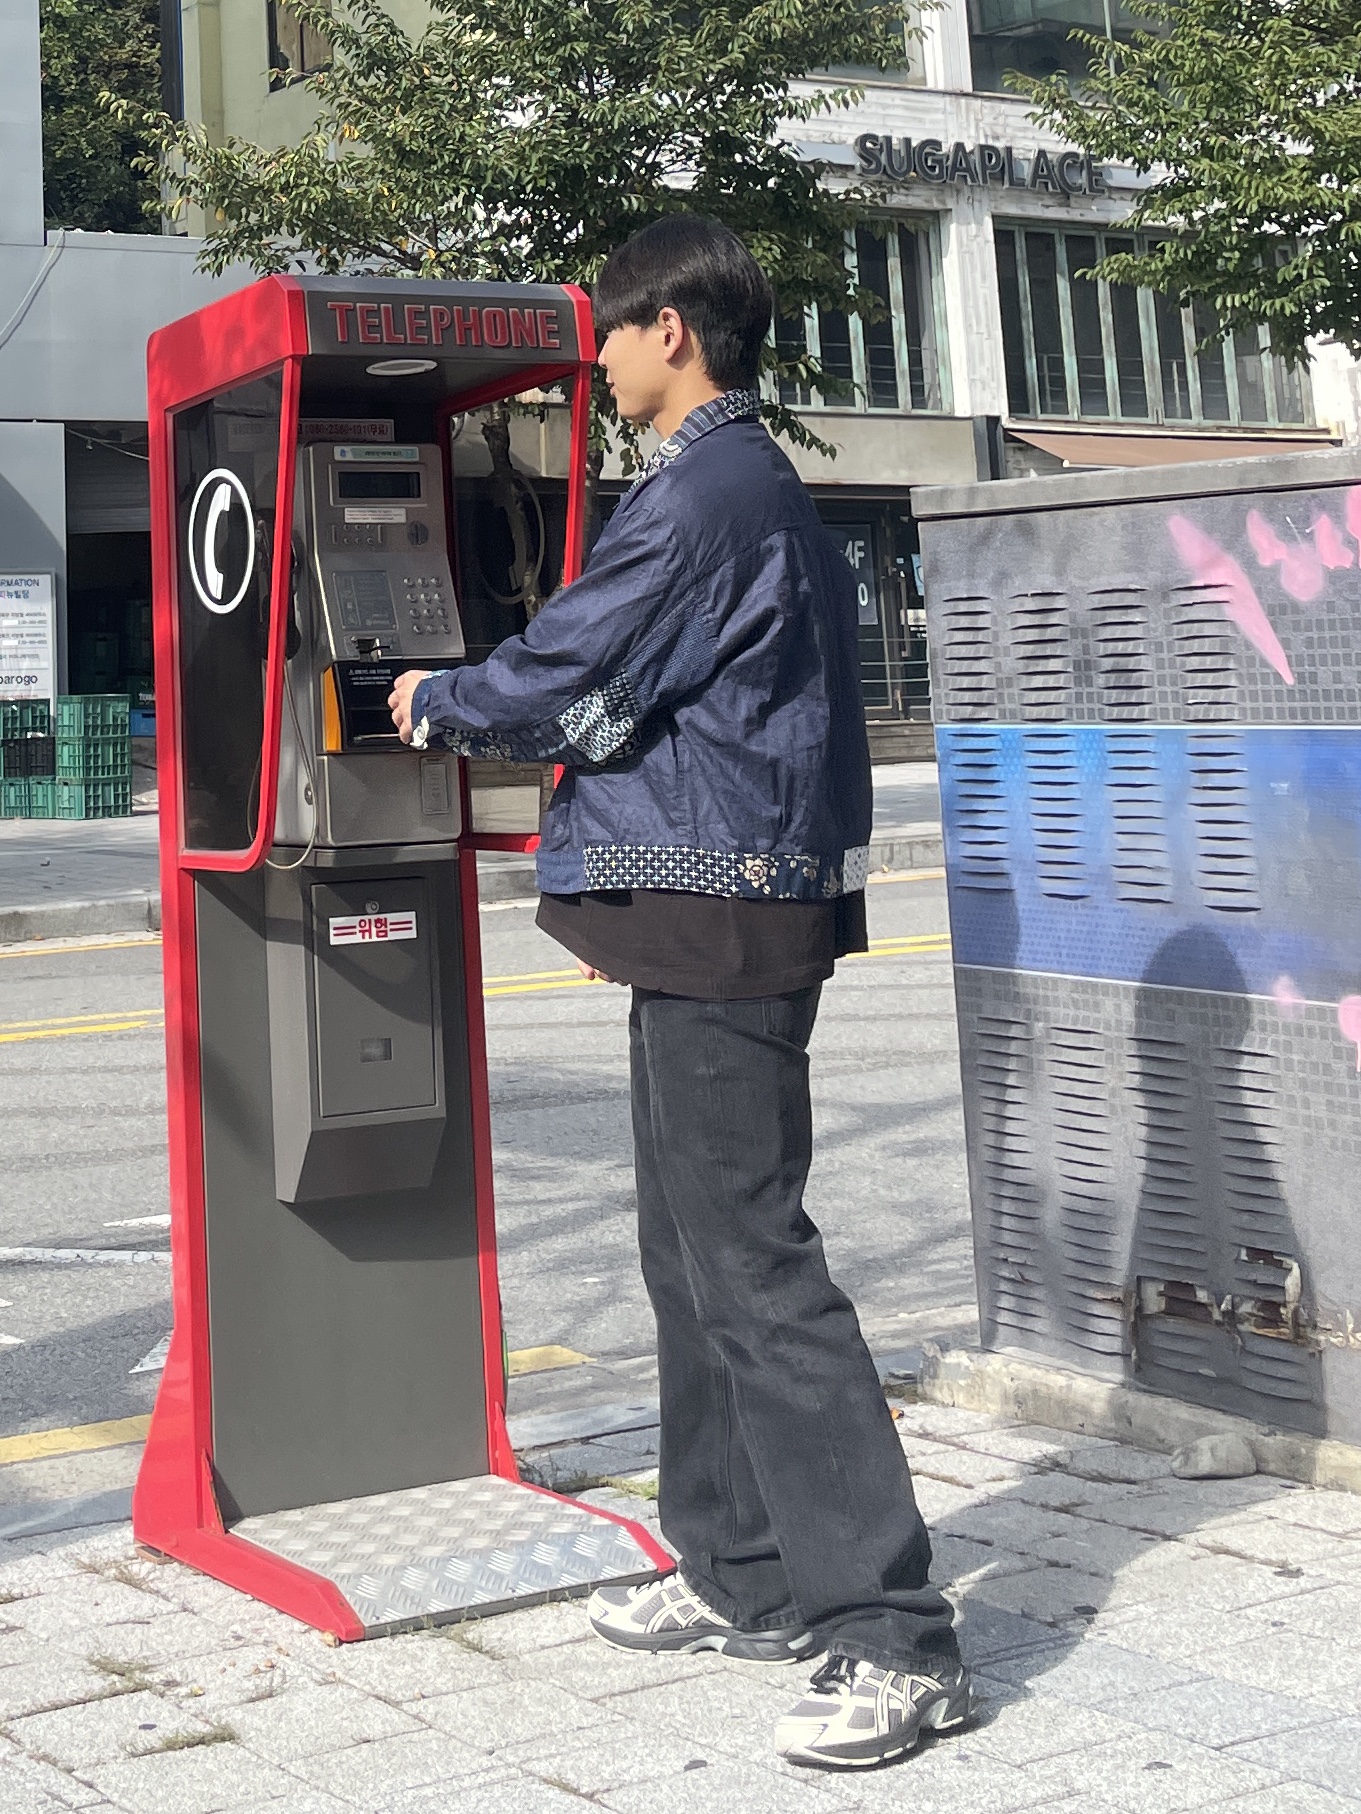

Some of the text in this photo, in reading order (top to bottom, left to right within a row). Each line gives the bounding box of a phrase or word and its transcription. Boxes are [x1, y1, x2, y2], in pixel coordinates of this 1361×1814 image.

[854, 133, 1106, 195] SUGAPLACE
[327, 301, 561, 348] TELEPHONE
[358, 917, 388, 940] 위험
